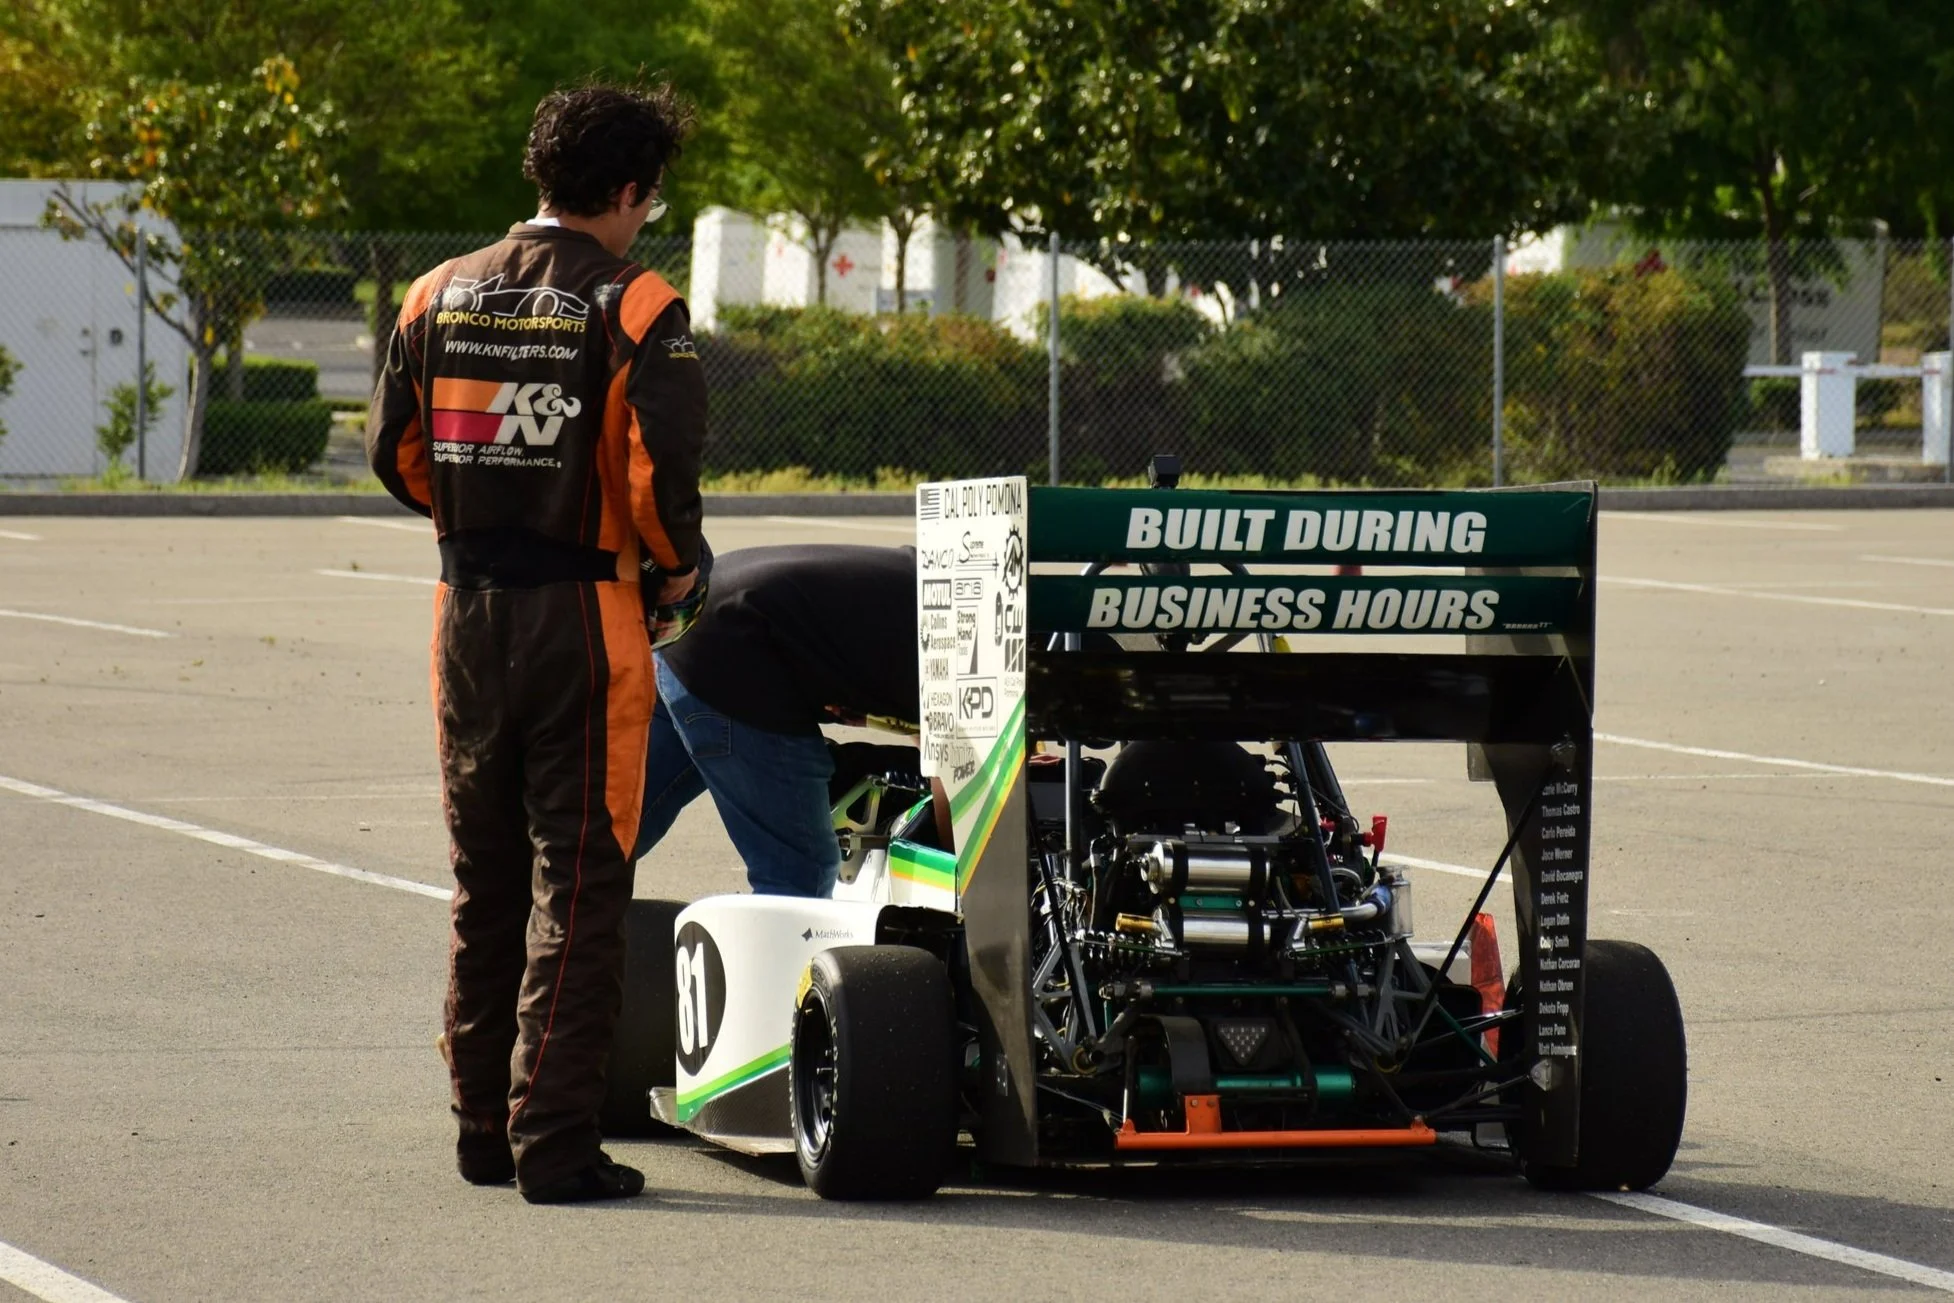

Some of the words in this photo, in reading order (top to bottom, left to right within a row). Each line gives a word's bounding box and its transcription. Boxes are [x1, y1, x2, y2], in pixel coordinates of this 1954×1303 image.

[436, 311, 489, 328] BRONCO
[494, 315, 586, 333] MOTORSPORTS
[445, 340, 578, 362] WWW.KNFILTERS.COM
[433, 441, 474, 454] SUPERIOR
[478, 445, 524, 457] AIRFLOW.
[434, 452, 473, 464] SUPERIOR
[945, 488, 959, 519] CAL
[963, 485, 983, 518] POLY
[986, 482, 1022, 516] POMONA
[1126, 508, 1276, 551] BUILT
[1284, 510, 1487, 553] DURING
[921, 548, 954, 570] DANCO
[923, 582, 951, 607] MOTUL
[1086, 585, 1326, 629] BUSINESS
[1332, 588, 1500, 630] HOURS
[931, 613, 947, 629] Collins
[957, 610, 976, 628] Strong
[931, 634, 955, 653] Aerospace
[957, 627, 972, 641] Hand
[930, 658, 949, 681] YAMAHA
[931, 692, 953, 707] HEXAGON
[959, 686, 994, 720] KPD
[924, 735, 949, 768] Ansys
[1563, 803, 1580, 816] Castro
[676, 942, 708, 1056] 81
